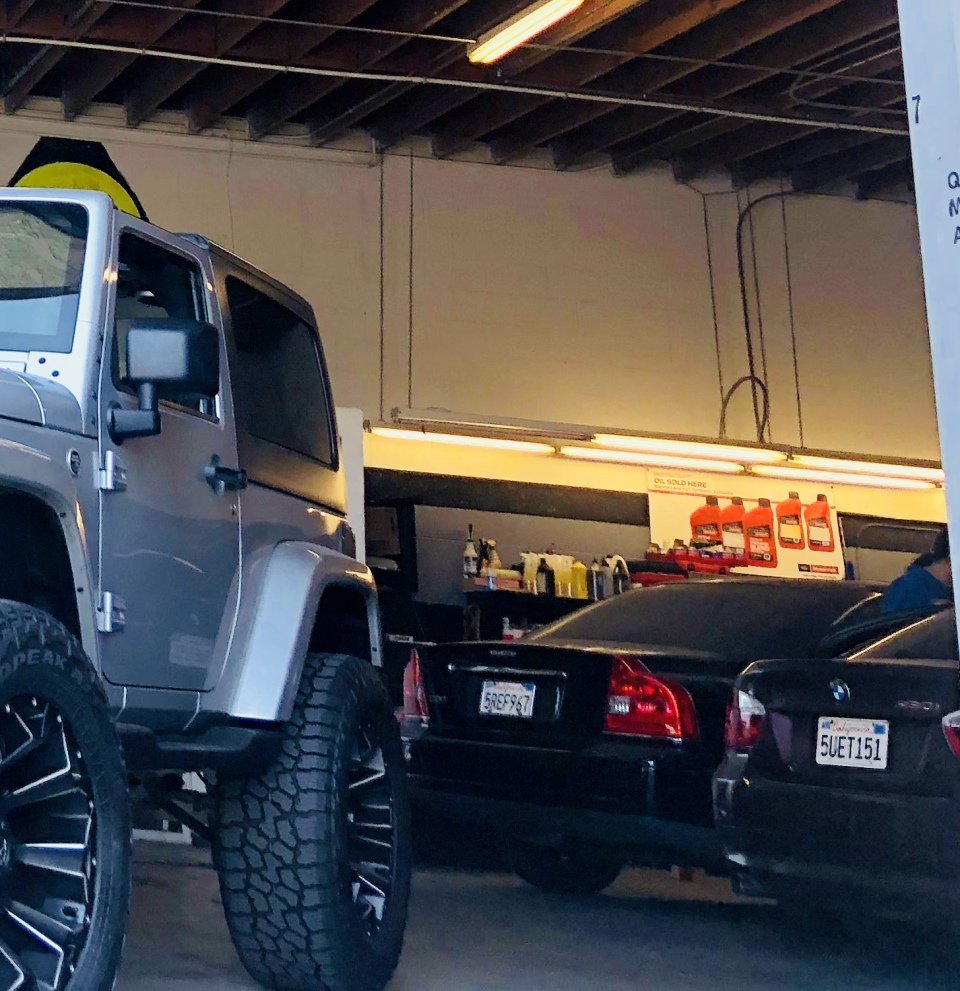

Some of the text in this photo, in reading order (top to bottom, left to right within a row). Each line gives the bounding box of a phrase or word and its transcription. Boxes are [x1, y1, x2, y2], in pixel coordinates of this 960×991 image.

[911, 94, 921, 124] 7
[666, 479, 687, 487] SOLD
[687, 480, 707, 489] HERE
[820, 734, 882, 761] 5UET151
